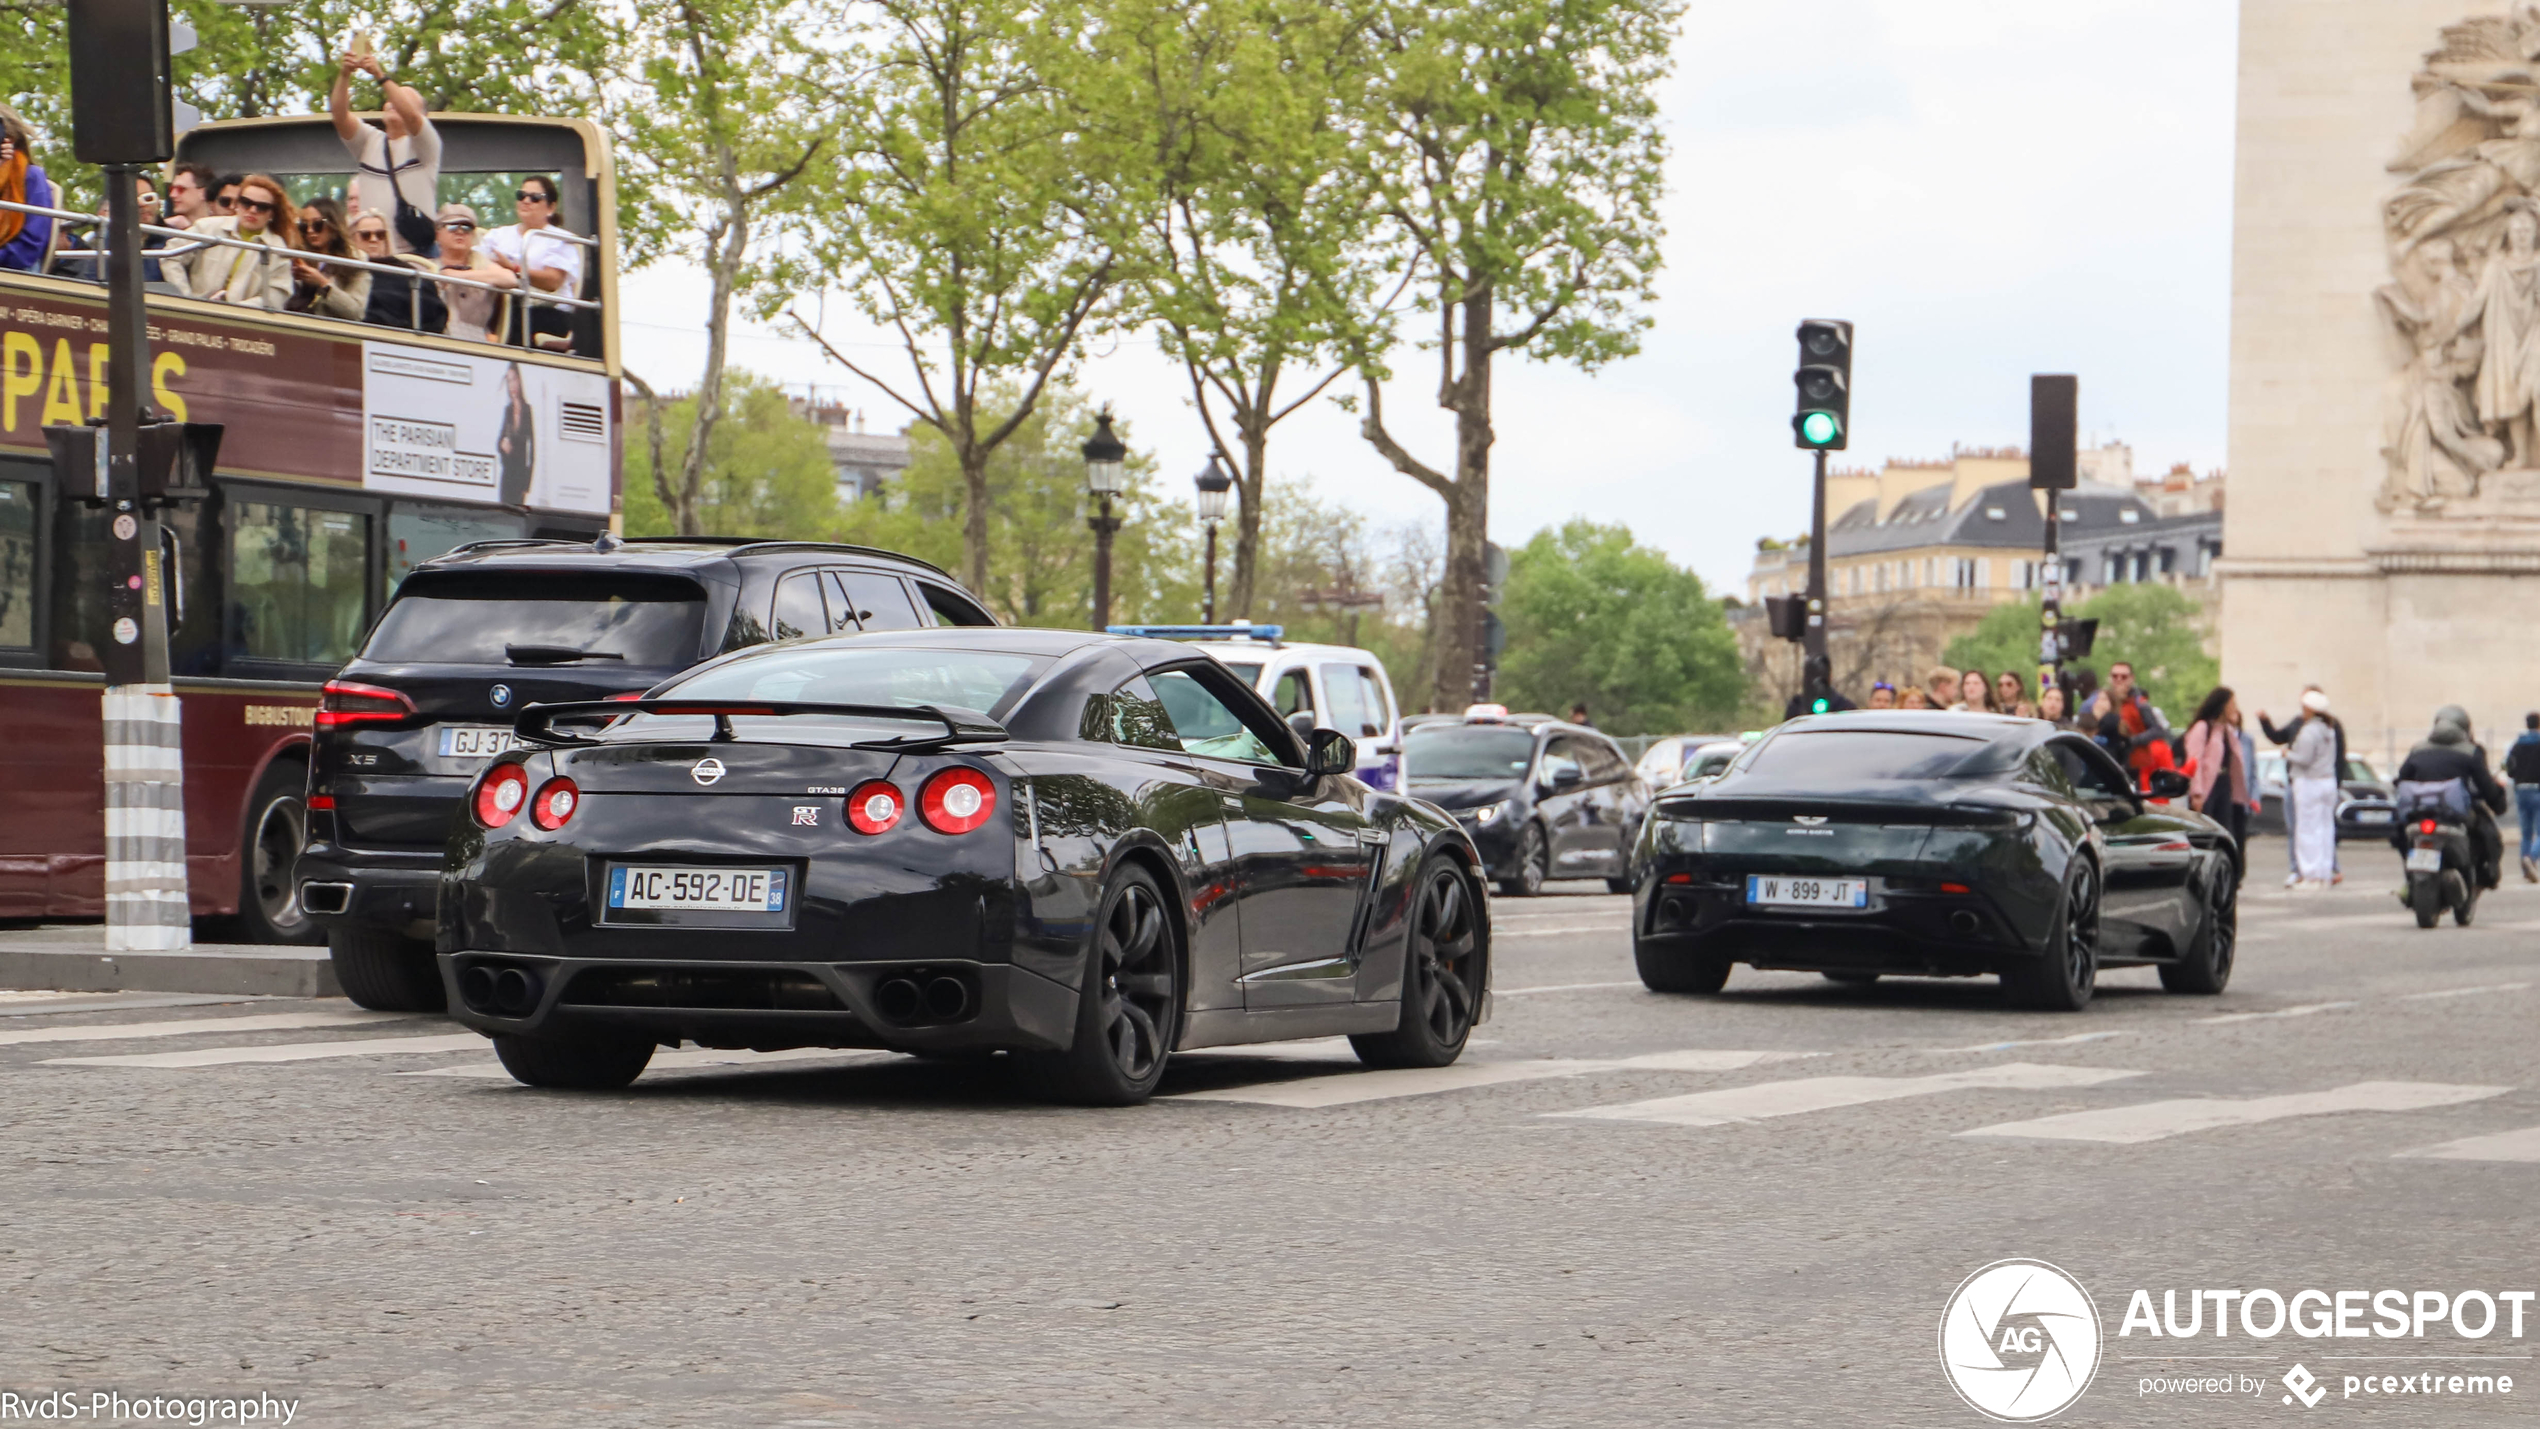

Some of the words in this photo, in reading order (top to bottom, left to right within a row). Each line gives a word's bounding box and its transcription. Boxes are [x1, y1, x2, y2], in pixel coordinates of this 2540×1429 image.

[46, 312, 83, 330] GARNIER
[375, 422, 397, 443] THE
[401, 425, 455, 450] PARISIAN
[374, 449, 450, 476] DEPARTMENT
[454, 457, 491, 480] STORE
[350, 754, 377, 766] X5
[631, 872, 764, 903] AC-592-DE
[769, 892, 781, 905] 38
